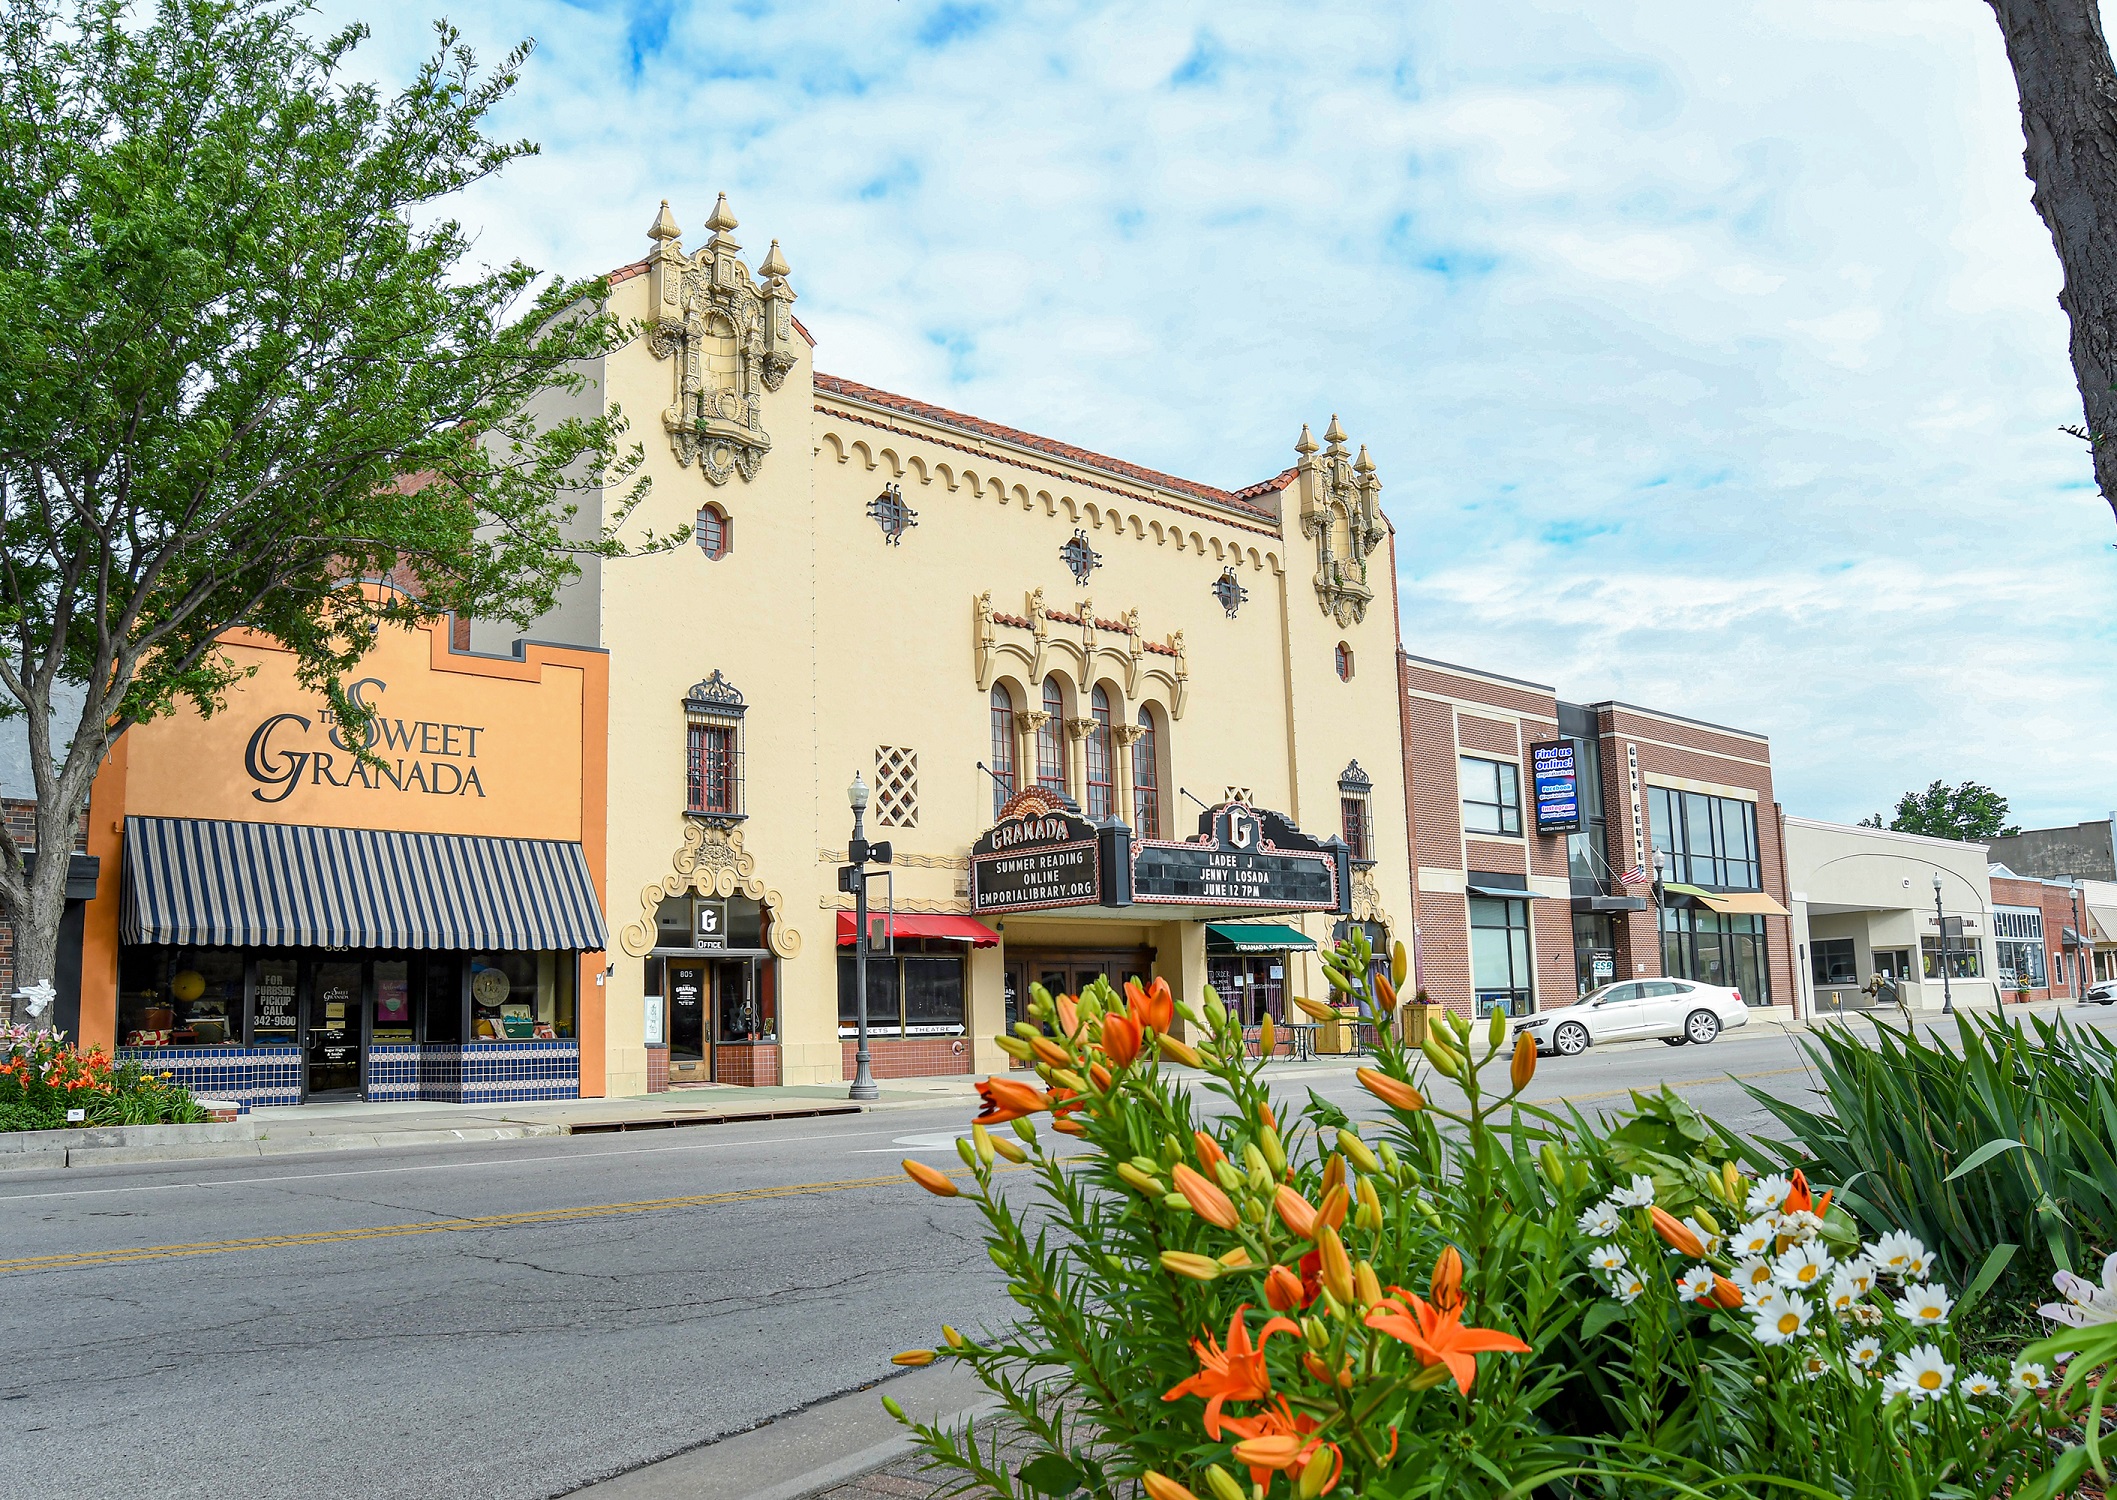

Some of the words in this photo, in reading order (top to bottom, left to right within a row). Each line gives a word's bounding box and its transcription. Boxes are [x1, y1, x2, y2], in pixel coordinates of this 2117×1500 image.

[244, 713, 487, 803] GRANADA
[1535, 748, 1557, 759] Find
[1559, 748, 1572, 757] us
[1536, 758, 1573, 770] Online!
[1629, 747, 1638, 791] ARTS
[1542, 784, 1572, 793] Facebook
[1541, 804, 1575, 812] Instagram
[991, 818, 1069, 850] GRANADA
[1228, 807, 1252, 849] G
[996, 858, 1035, 874] SUMMER
[1040, 852, 1083, 868] READING
[1209, 854, 1237, 867] LADEE
[1247, 857, 1253, 868] J
[1023, 870, 1059, 885] ONLINE
[1200, 869, 1228, 881] JENNY
[1236, 870, 1269, 883] LOSADA
[980, 882, 1091, 905] EMPORIALIBRARY.ORG
[1203, 884, 1226, 895] JUNE
[1230, 884, 1239, 896] 12
[1242, 885, 1260, 897] 7PM
[701, 909, 718, 932] G
[1595, 961, 1612, 970] ESB
[680, 970, 693, 978] 805
[265, 975, 283, 986] FOR
[255, 986, 295, 996] CURBSIDE
[260, 996, 291, 1006] PICKUP
[263, 1005, 284, 1016] CALL
[254, 1016, 296, 1026] 342-9600
